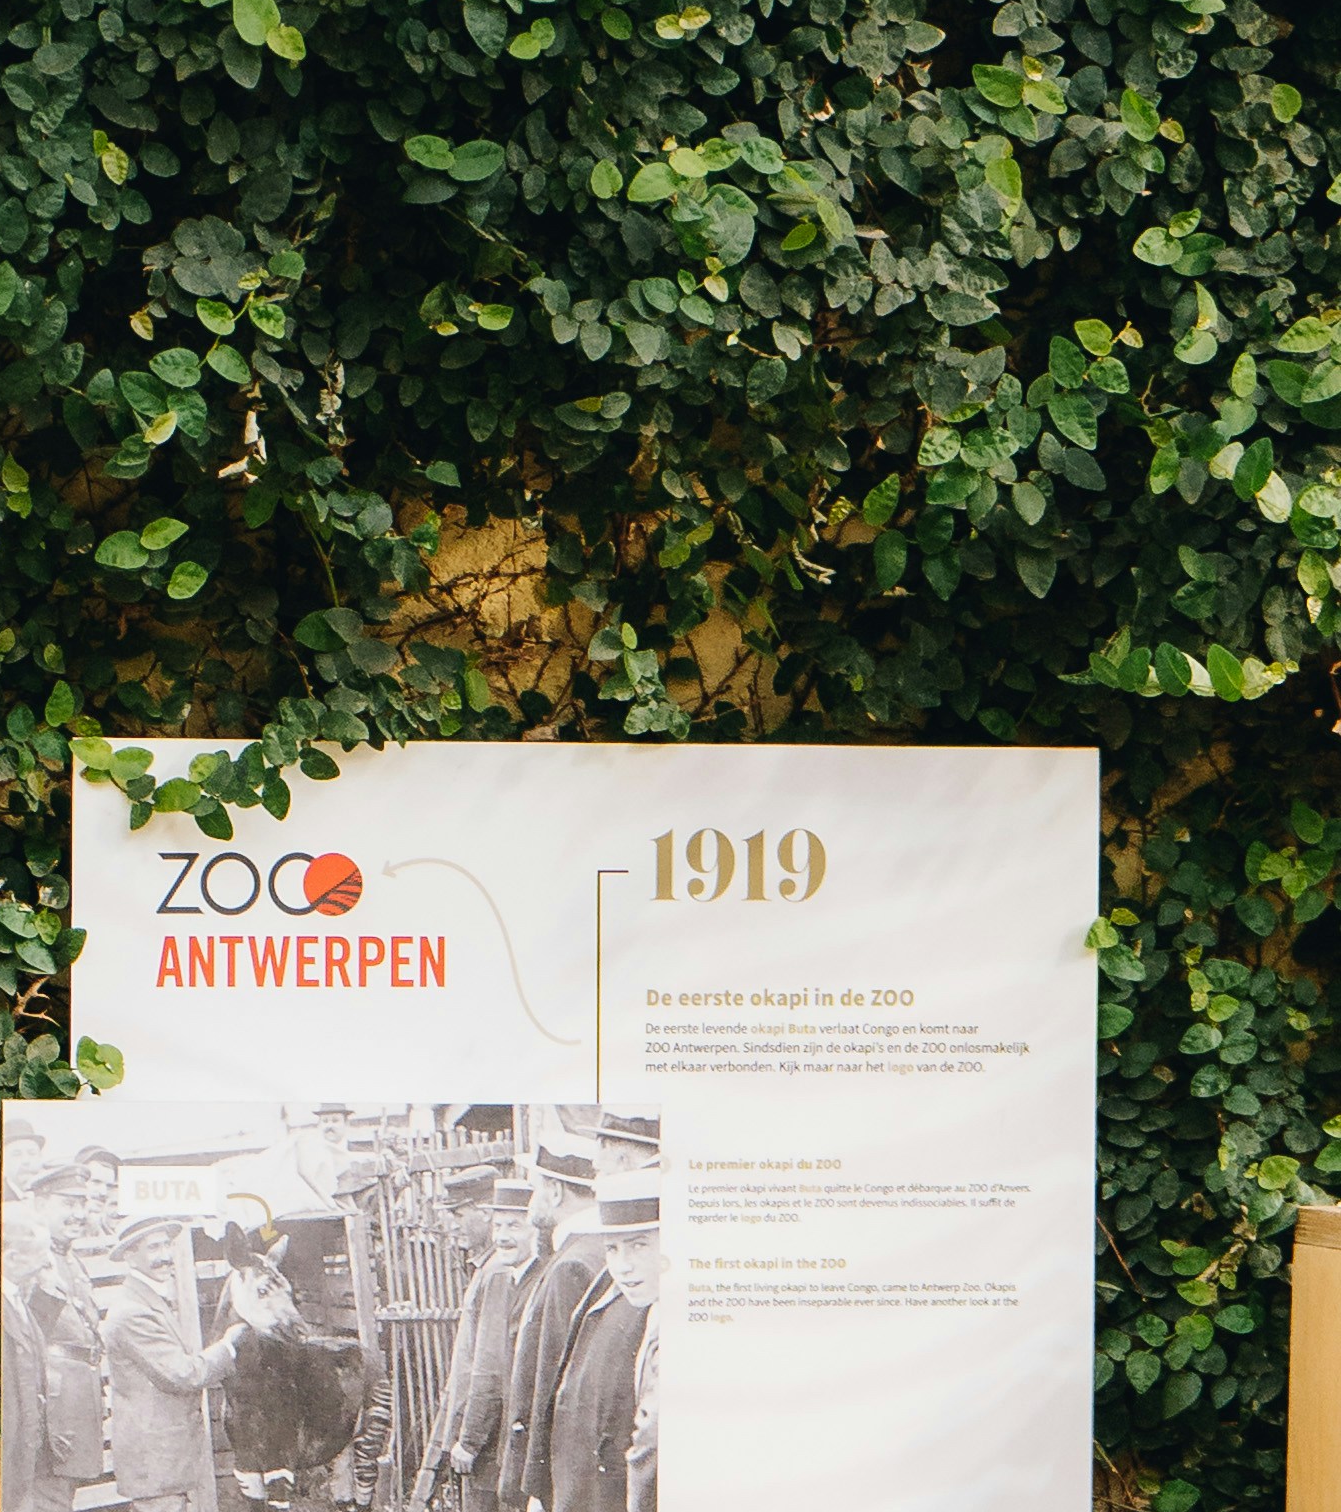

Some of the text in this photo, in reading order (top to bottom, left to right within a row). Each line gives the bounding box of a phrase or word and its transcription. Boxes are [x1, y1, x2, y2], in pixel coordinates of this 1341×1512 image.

[649, 828, 827, 903] 1919
[156, 935, 445, 988] ANTWERPEN
[646, 988, 915, 1012] De eerste okapi in de ZOO
[645, 1023, 979, 1039] De eerste levende okapi Buta verlaat Congo en komt naar
[645, 1042, 670, 1054] ZOO
[743, 1042, 800, 1054] Sindsdien
[803, 1042, 823, 1058] zijn
[826, 1042, 841, 1054] de
[887, 1045, 901, 1054] en
[904, 1042, 919, 1055] de
[921, 1042, 946, 1055] ZOO
[949, 1042, 1030, 1058] onlosmakelijk
[645, 1061, 668, 1074] met
[670, 1061, 708, 1074] elkaar
[779, 1061, 801, 1077] Kijk
[803, 1064, 834, 1074] maar
[836, 1064, 862, 1074] naar
[865, 1061, 885, 1074] het
[888, 1061, 914, 1077] logo
[916, 1064, 937, 1074] van
[939, 1061, 955, 1074] de
[688, 1158, 842, 1174] Le premier okapi du ZOO
[135, 1180, 201, 1200] BUTA
[689, 1257, 847, 1273] The first okapi in the ZOO
